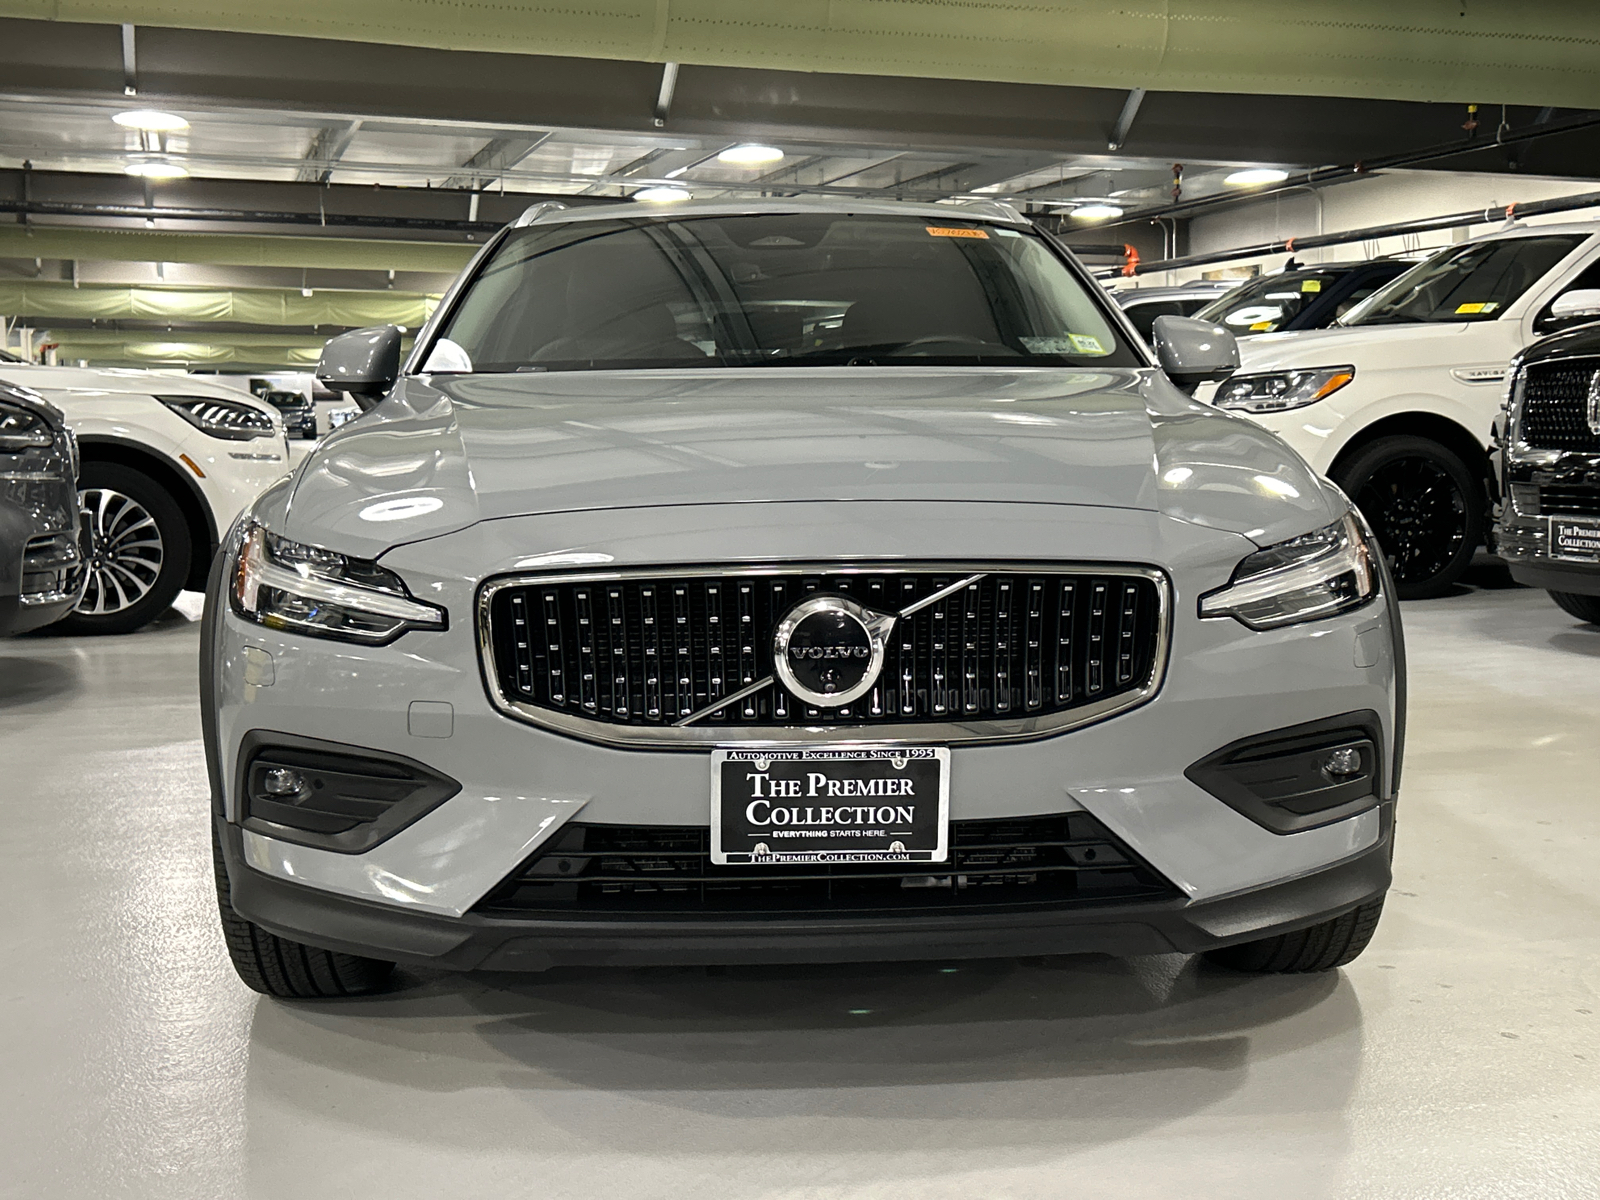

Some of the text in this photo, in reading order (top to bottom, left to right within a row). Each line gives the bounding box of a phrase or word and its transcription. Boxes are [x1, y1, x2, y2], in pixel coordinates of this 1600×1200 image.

[790, 646, 869, 659] VOLVO
[729, 748, 934, 760] AUTOMOTIVE EXCELLENCE SINCE 1995
[746, 772, 915, 798] THE PREMIER
[745, 799, 915, 825] COLLECTION
[772, 829, 888, 838] EVERYTHING STARTS HERE.
